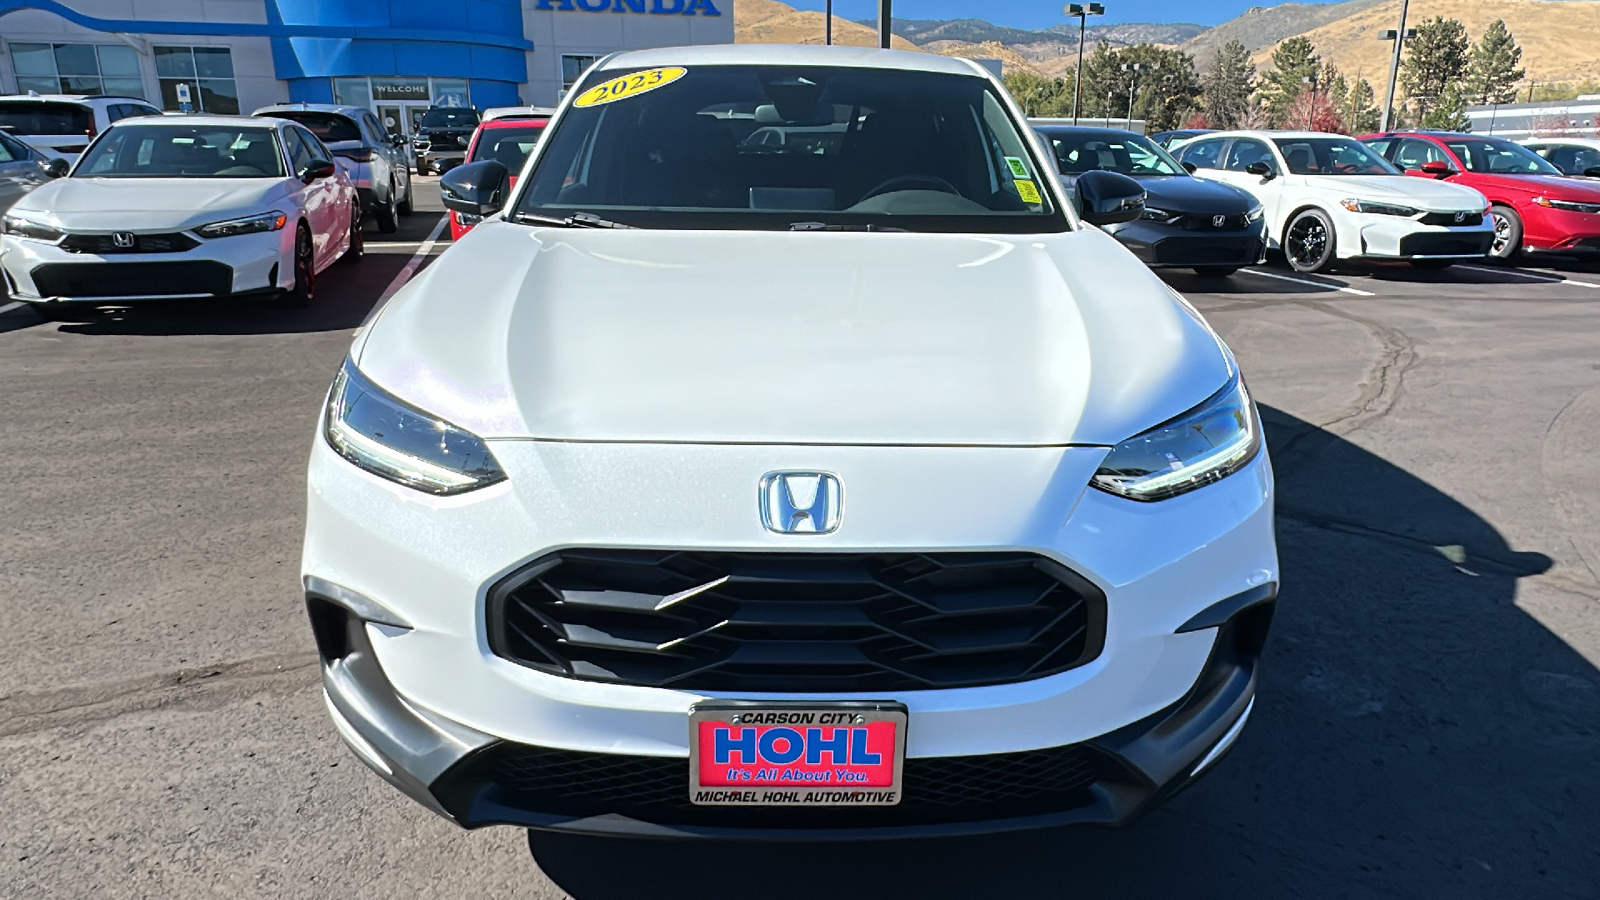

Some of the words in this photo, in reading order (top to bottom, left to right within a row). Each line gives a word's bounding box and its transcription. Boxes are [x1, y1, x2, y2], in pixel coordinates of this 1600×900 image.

[593, 70, 663, 103] 2023
[741, 712, 814, 724] CARSON
[819, 712, 857, 724] CITY
[714, 727, 882, 765] HOHL
[726, 768, 751, 781] It's
[754, 768, 780, 781] All
[781, 768, 831, 782] About
[835, 769, 868, 782] You.
[695, 791, 758, 803] MICHAEL
[762, 791, 800, 803] HOHL
[803, 791, 896, 803] AUTOMOTIVE
